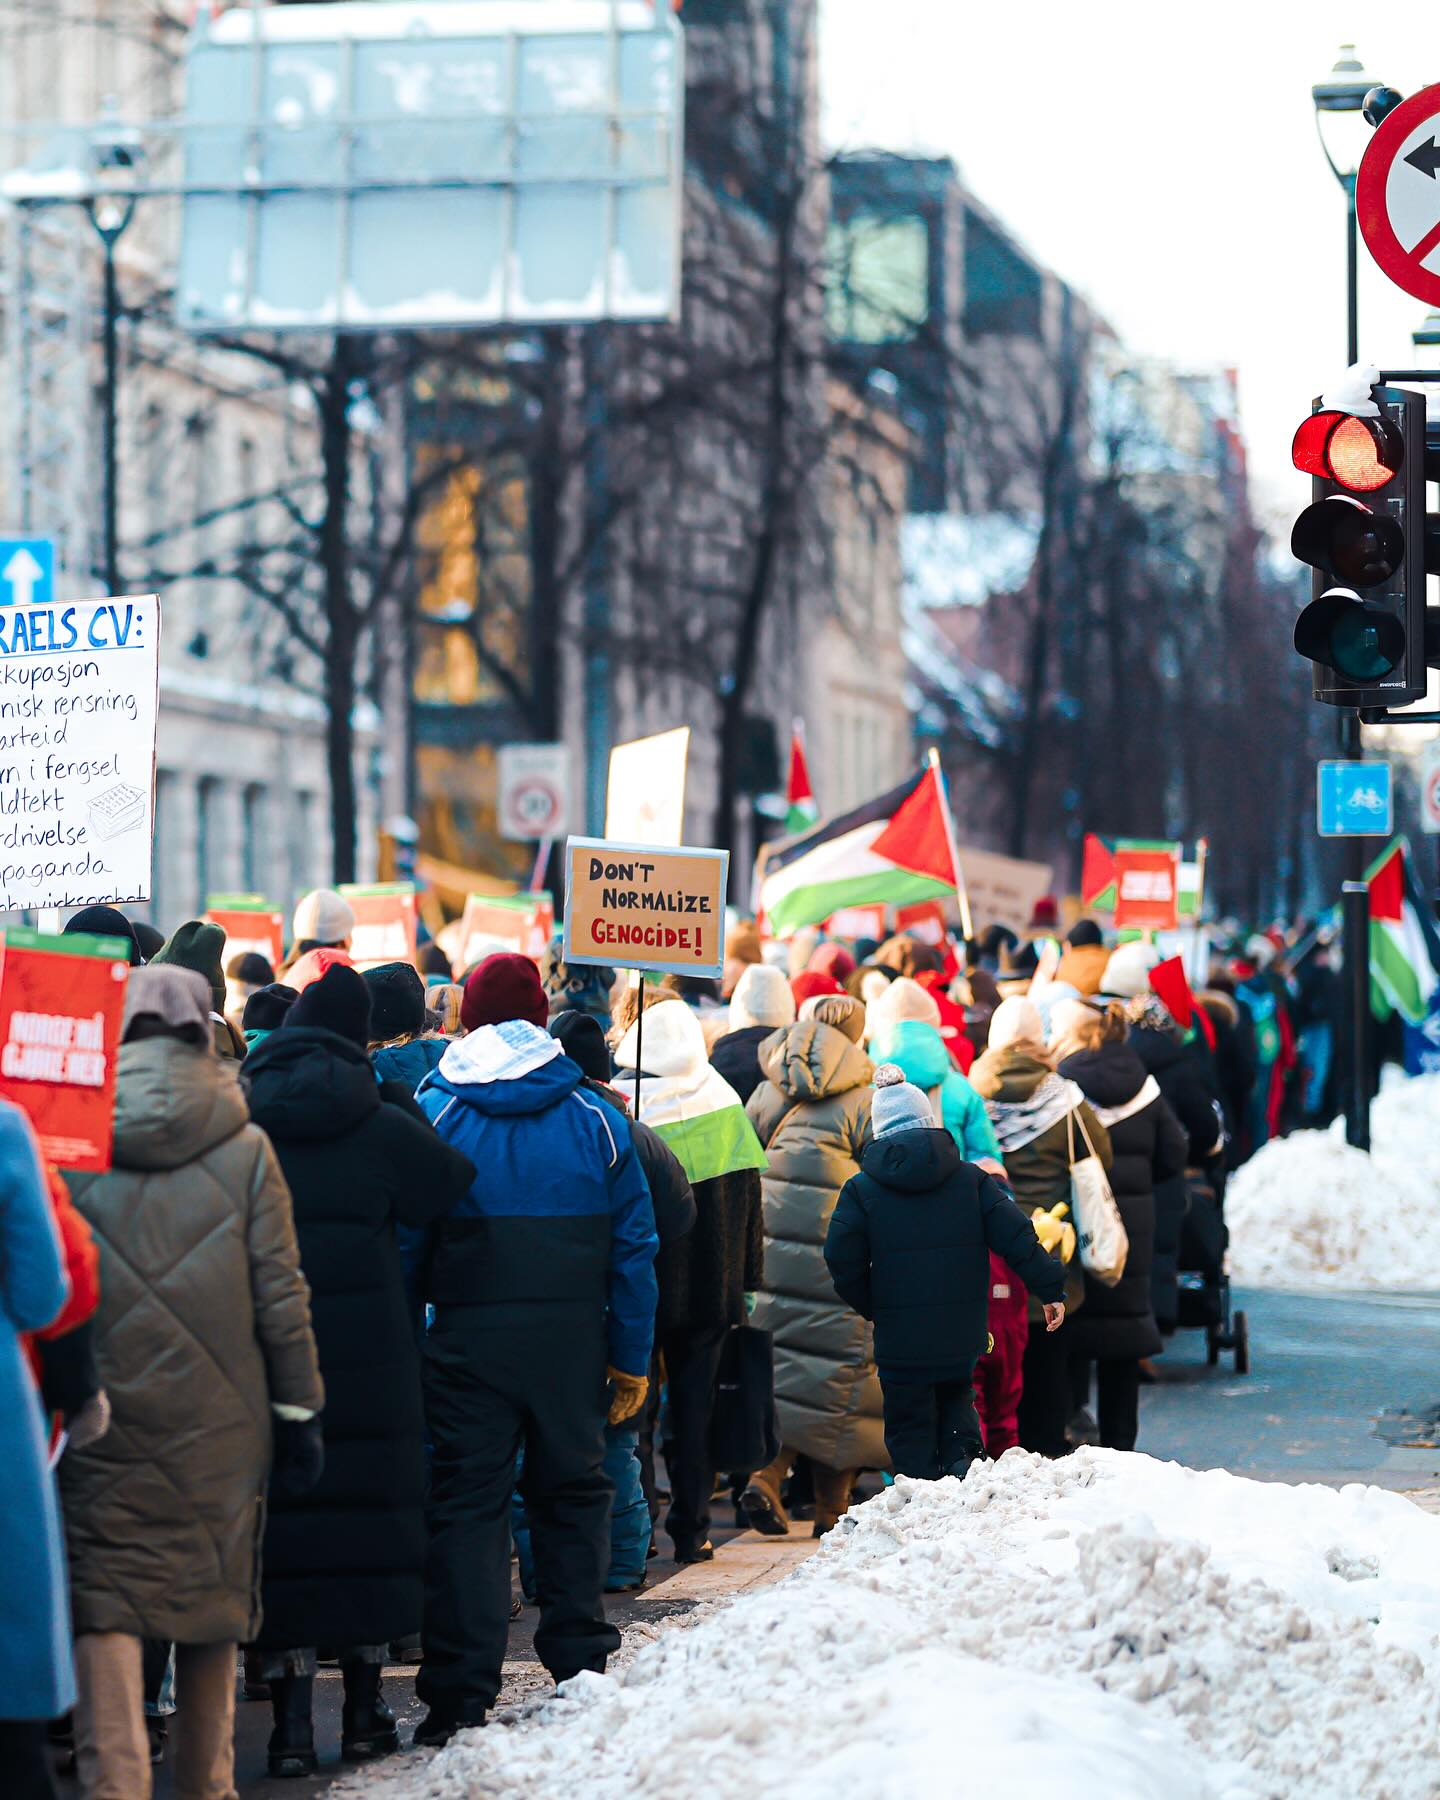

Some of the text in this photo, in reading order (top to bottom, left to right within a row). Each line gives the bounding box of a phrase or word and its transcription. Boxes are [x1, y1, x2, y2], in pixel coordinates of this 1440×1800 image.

[87, 604, 142, 648] CV:
[0, 660, 99, 690] kupasjon
[1, 689, 138, 720] nisk rensning
[30, 759, 35, 780] i
[46, 753, 120, 784] fengsel
[0, 787, 64, 814] ldtekt
[0, 851, 112, 888] paganda
[589, 858, 654, 882] DON'T
